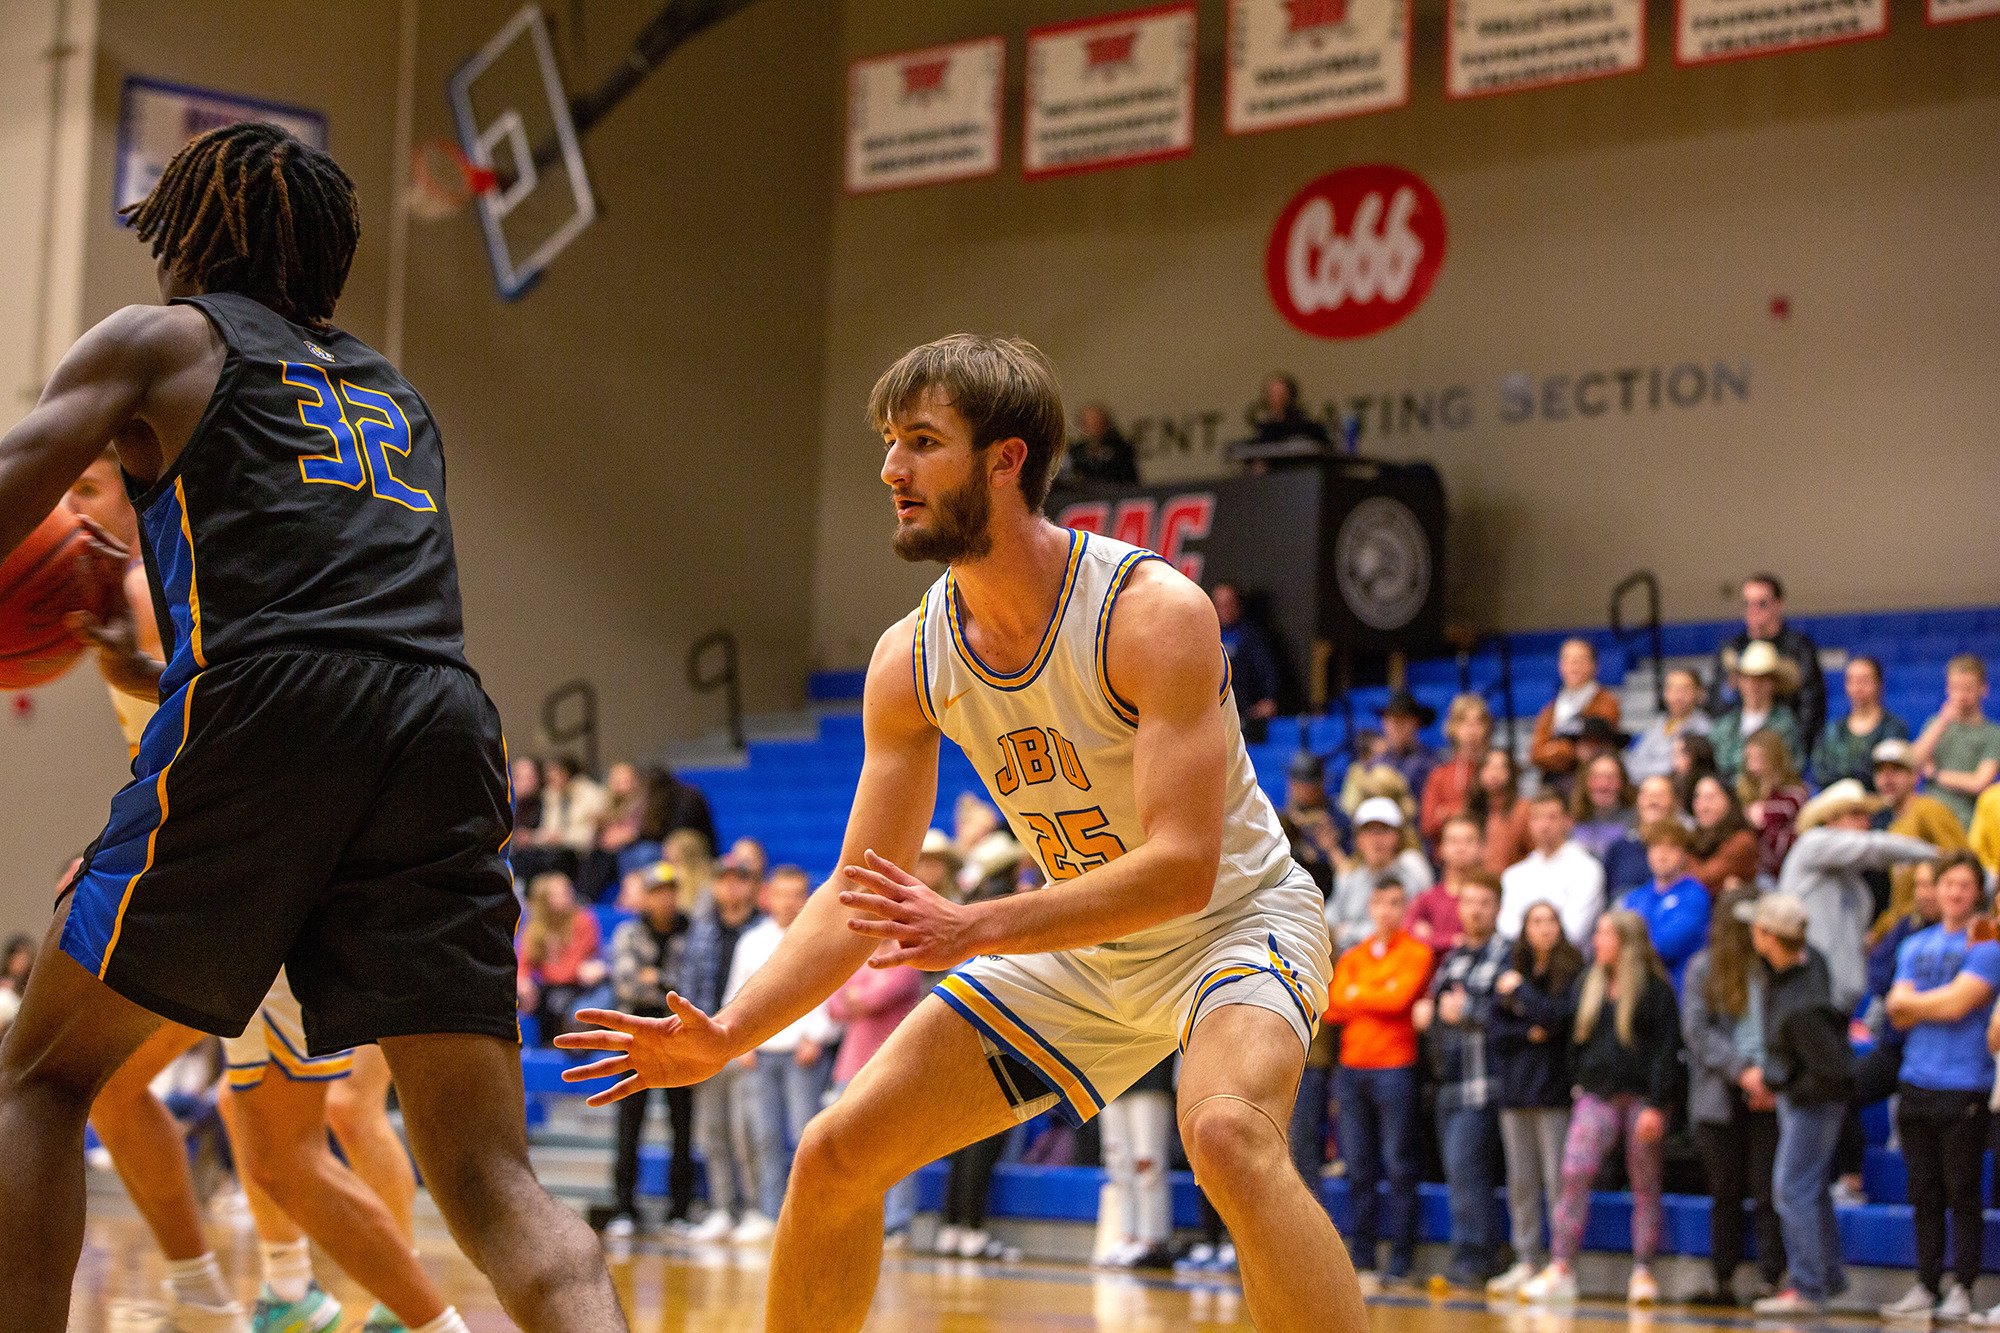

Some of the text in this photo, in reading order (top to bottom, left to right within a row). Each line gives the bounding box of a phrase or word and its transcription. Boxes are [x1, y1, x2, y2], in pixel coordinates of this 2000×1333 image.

[1285, 186, 1424, 315] Cobb
[278, 360, 438, 512] 32
[1130, 412, 1224, 458] ENT
[1499, 358, 1754, 424] SECTION
[995, 726, 1092, 796] JBU
[1019, 805, 1128, 881] 25
